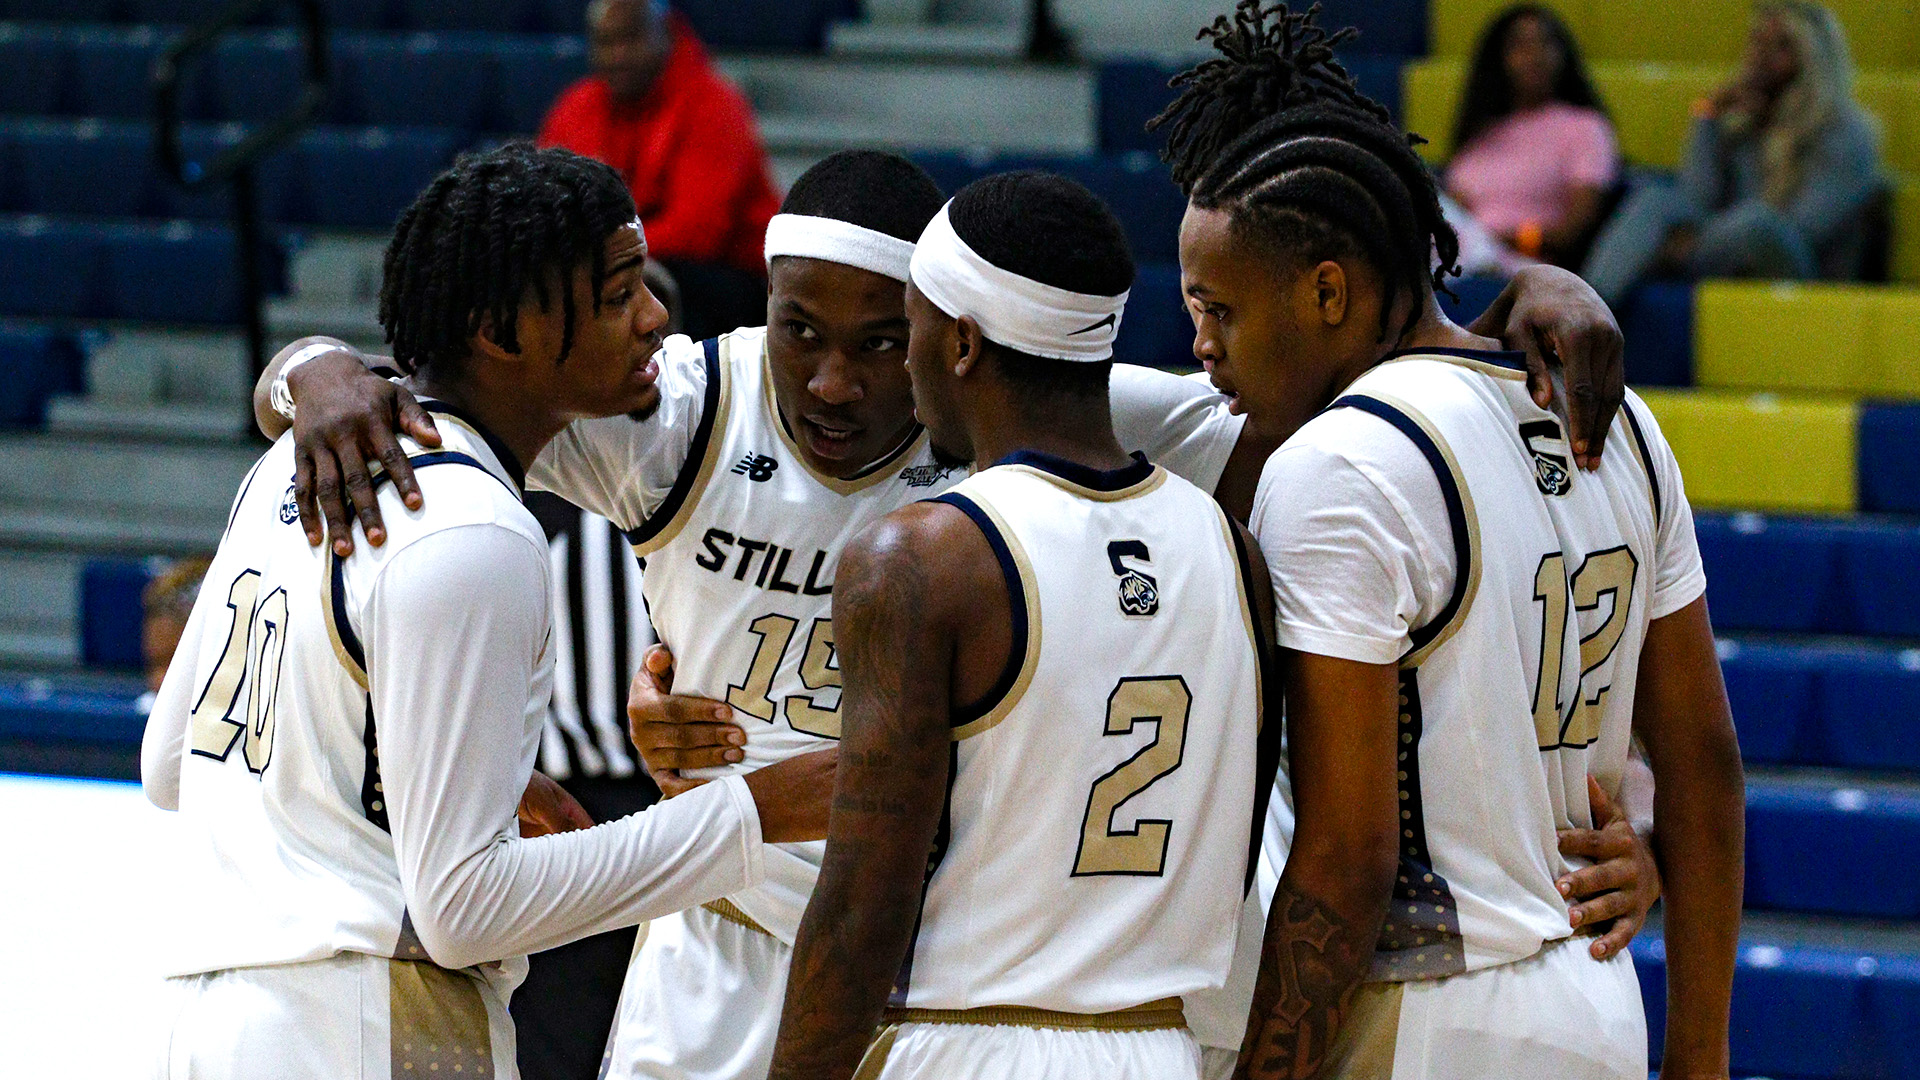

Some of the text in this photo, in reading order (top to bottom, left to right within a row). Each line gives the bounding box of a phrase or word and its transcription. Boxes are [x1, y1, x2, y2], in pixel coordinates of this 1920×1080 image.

[190, 567, 289, 776] 10
[725, 613, 843, 740] 15
[1531, 543, 1639, 752] 12
[1070, 674, 1193, 878] 2
